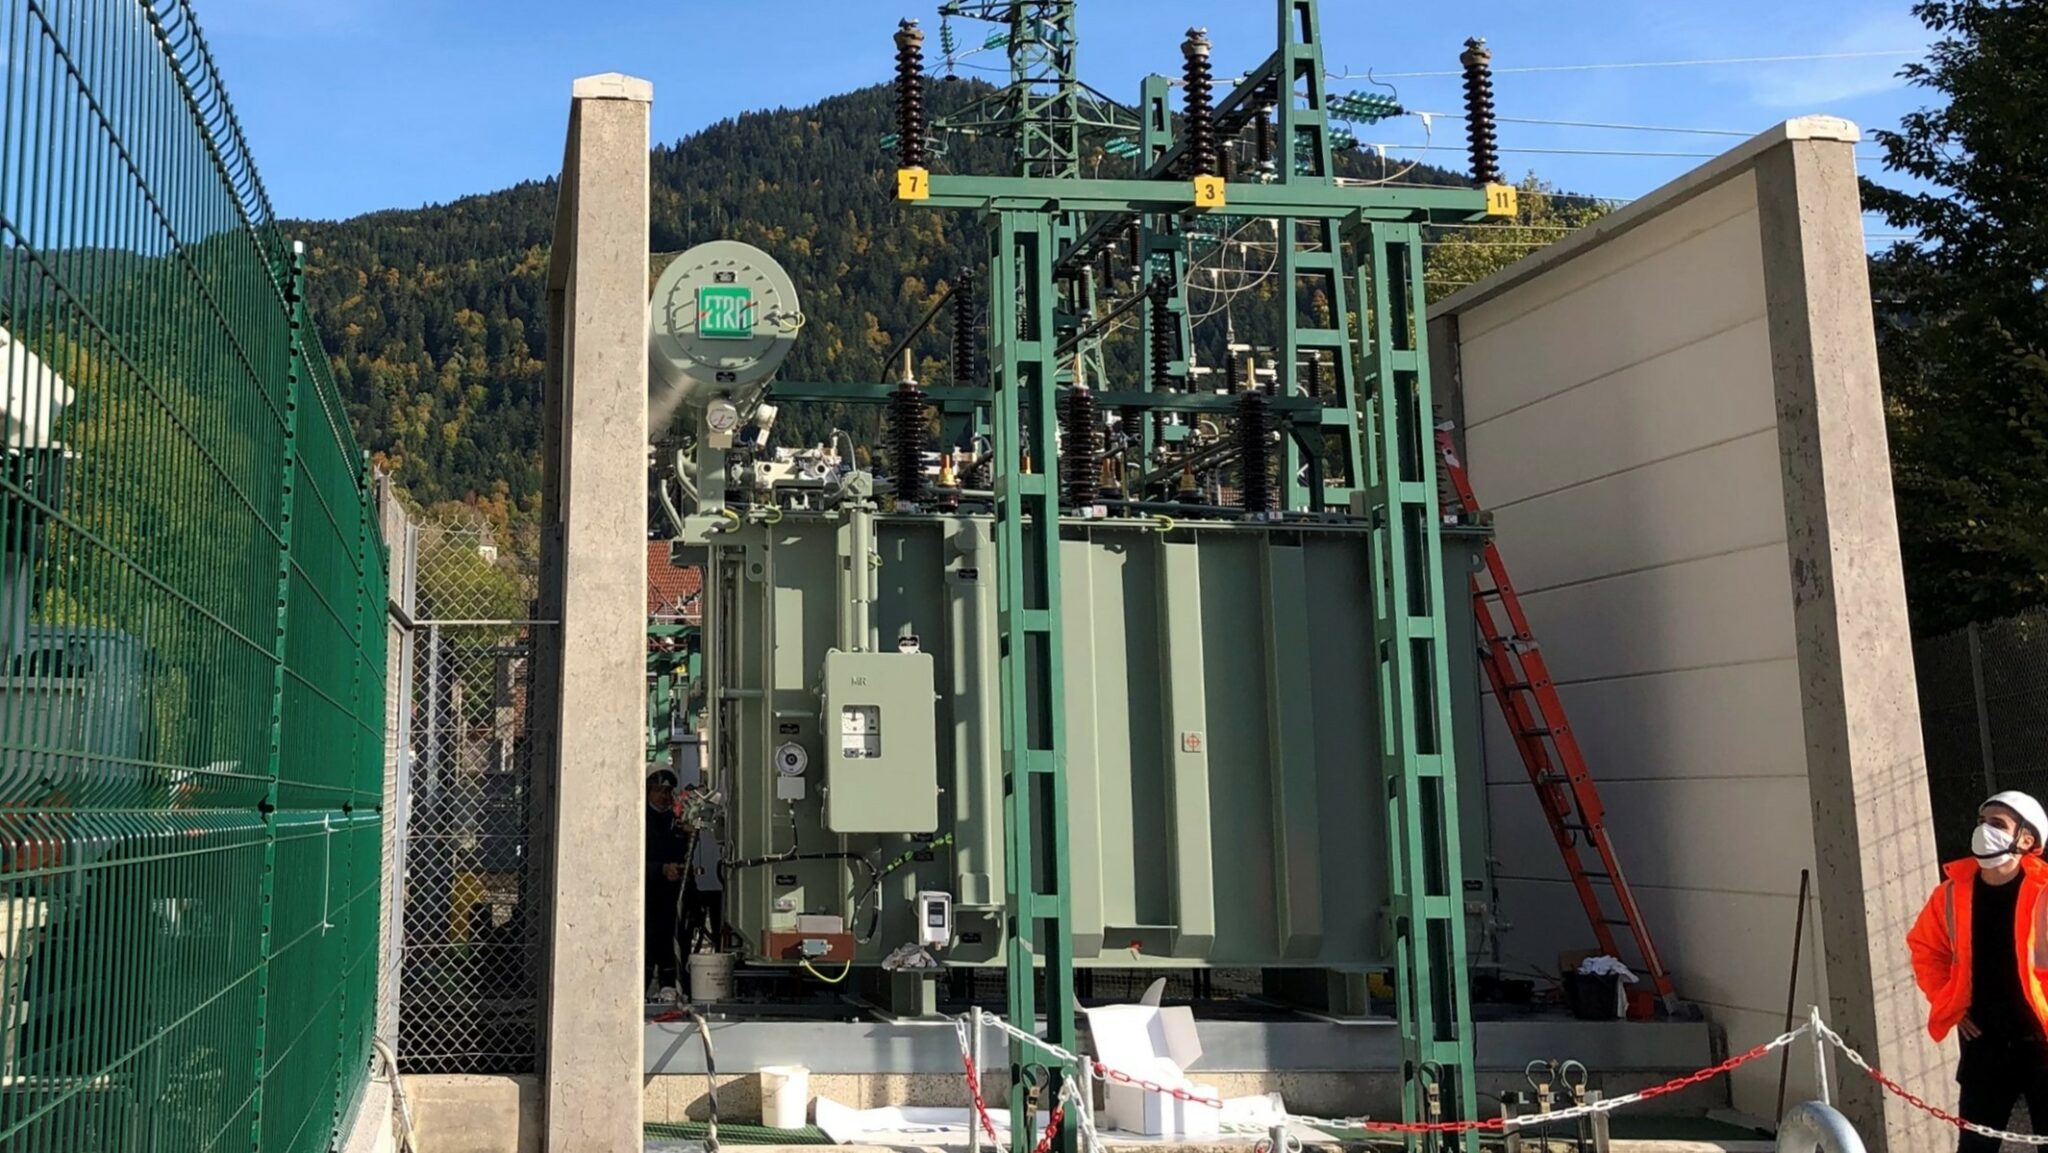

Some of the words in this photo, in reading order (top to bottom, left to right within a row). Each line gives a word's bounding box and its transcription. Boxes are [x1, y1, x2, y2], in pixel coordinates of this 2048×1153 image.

[909, 176, 918, 193] 7
[1205, 184, 1215, 200] 3
[1496, 192, 1508, 208] 11
[705, 295, 748, 329] ETRA
